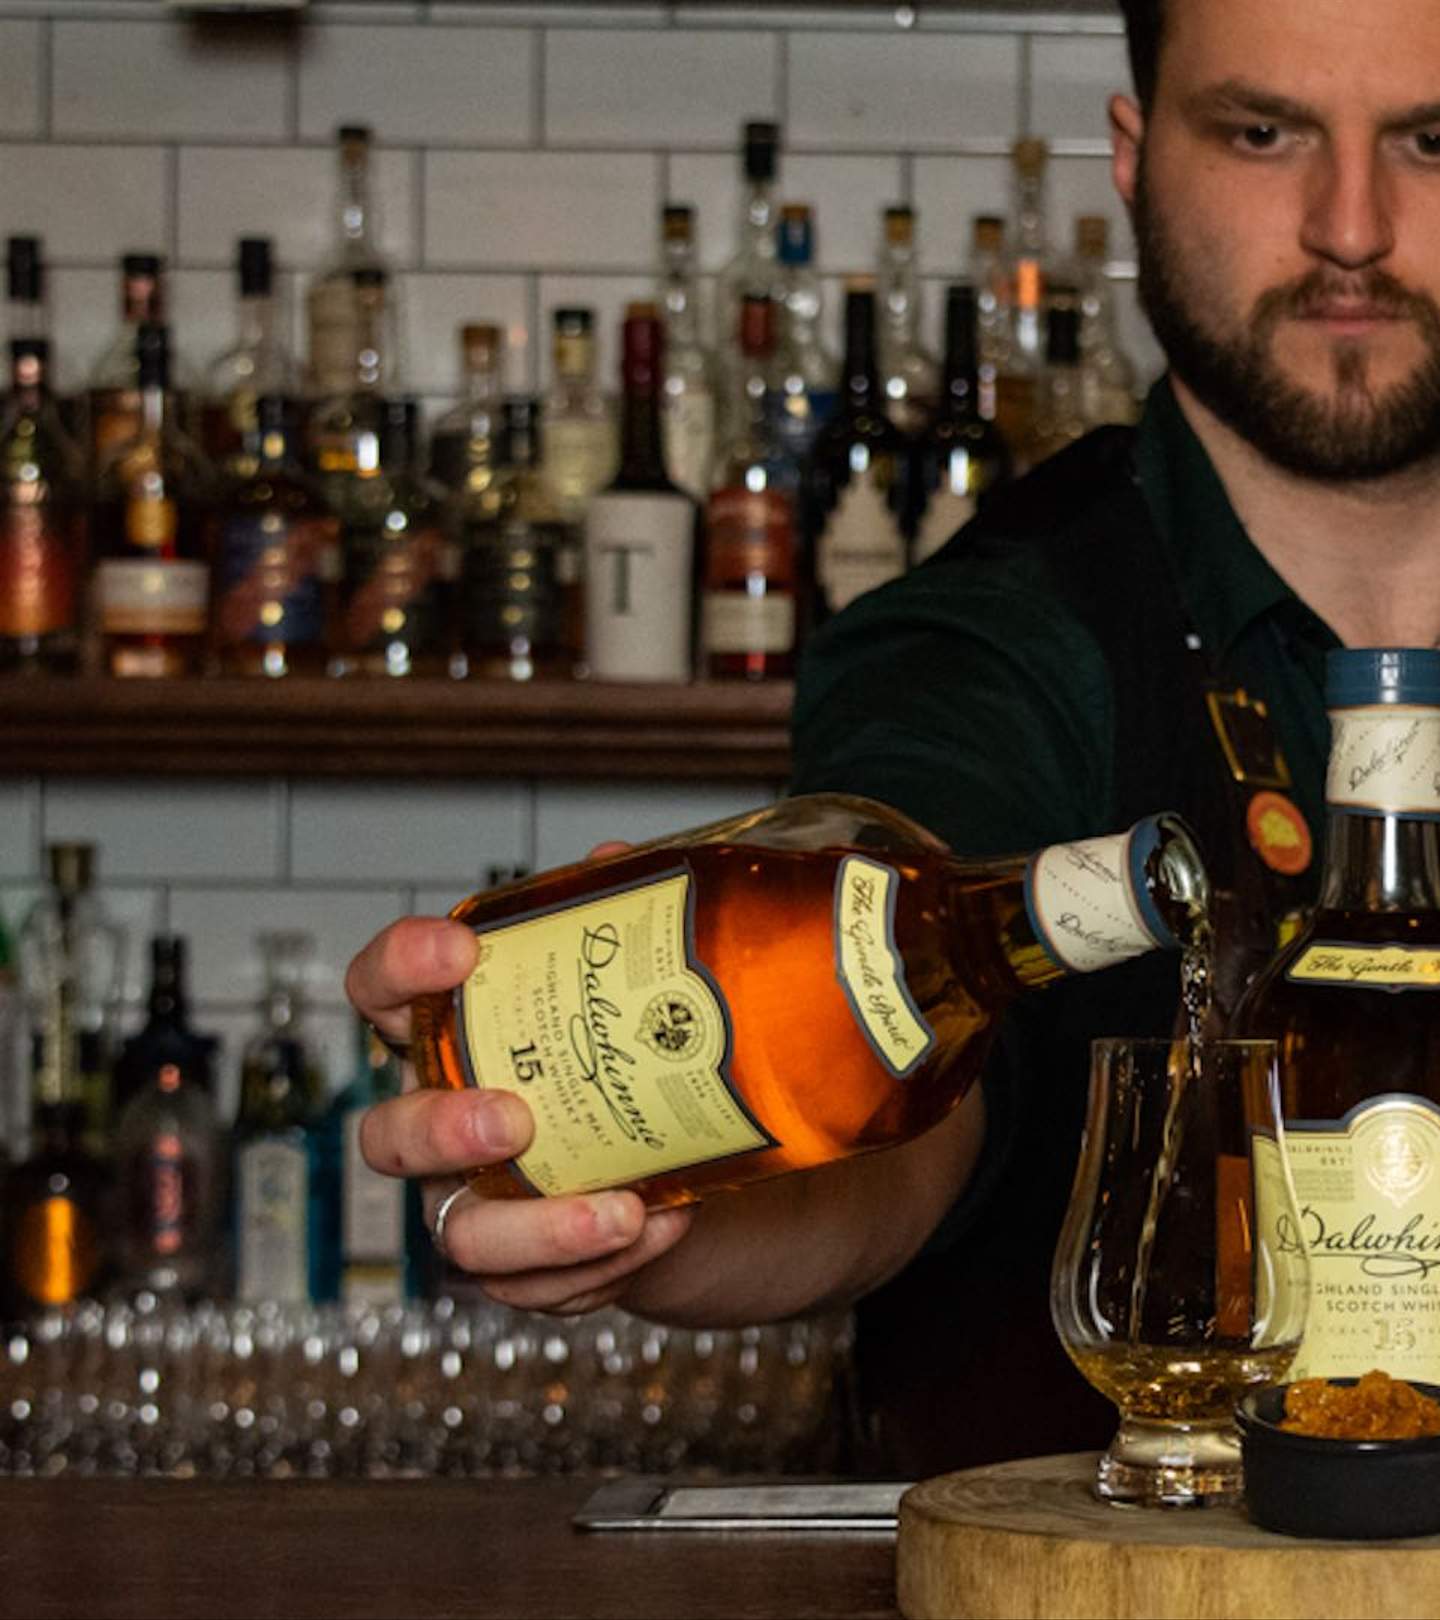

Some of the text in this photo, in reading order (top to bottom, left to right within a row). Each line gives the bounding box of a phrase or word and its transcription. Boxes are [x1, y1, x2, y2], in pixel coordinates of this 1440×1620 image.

[600, 543, 654, 615] T
[848, 876, 915, 1052] The Gentle Spirit
[1306, 954, 1344, 972] The
[1348, 956, 1415, 980] Gentle
[509, 1040, 545, 1085] 15
[532, 986, 557, 1059] SCOTCH
[548, 1062, 582, 1126] WHISKY
[547, 951, 614, 1148] HIGHLAND SINGLE MALT
[571, 922, 665, 1151] Dalwhinnie
[1326, 1300, 1395, 1313] SCOTCH
[1374, 1318, 1416, 1350] 15
